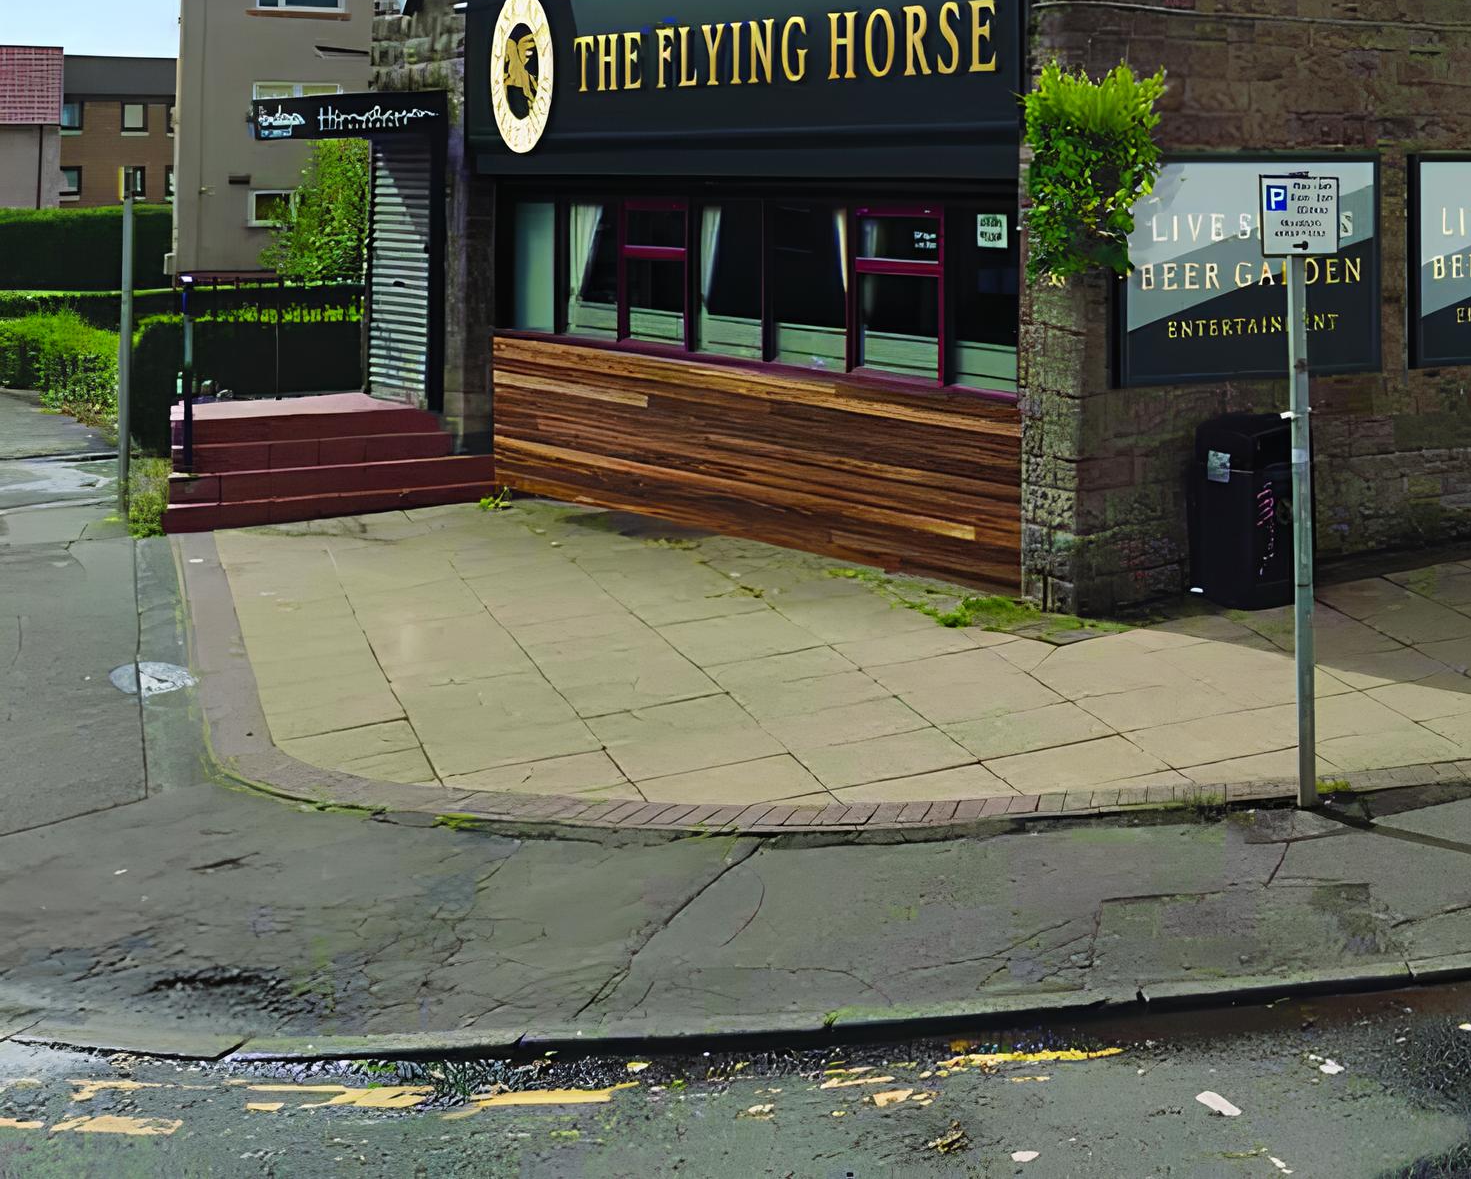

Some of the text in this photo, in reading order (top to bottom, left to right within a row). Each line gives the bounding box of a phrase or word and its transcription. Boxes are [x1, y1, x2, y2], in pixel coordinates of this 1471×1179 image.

[573, 31, 642, 92] THE
[655, 16, 808, 89] FLYING
[1269, 187, 1285, 210] P
[1151, 212, 1225, 242] LIVE
[1141, 262, 1221, 291] BEER
[1168, 313, 1339, 338] ENTERTAINNT
